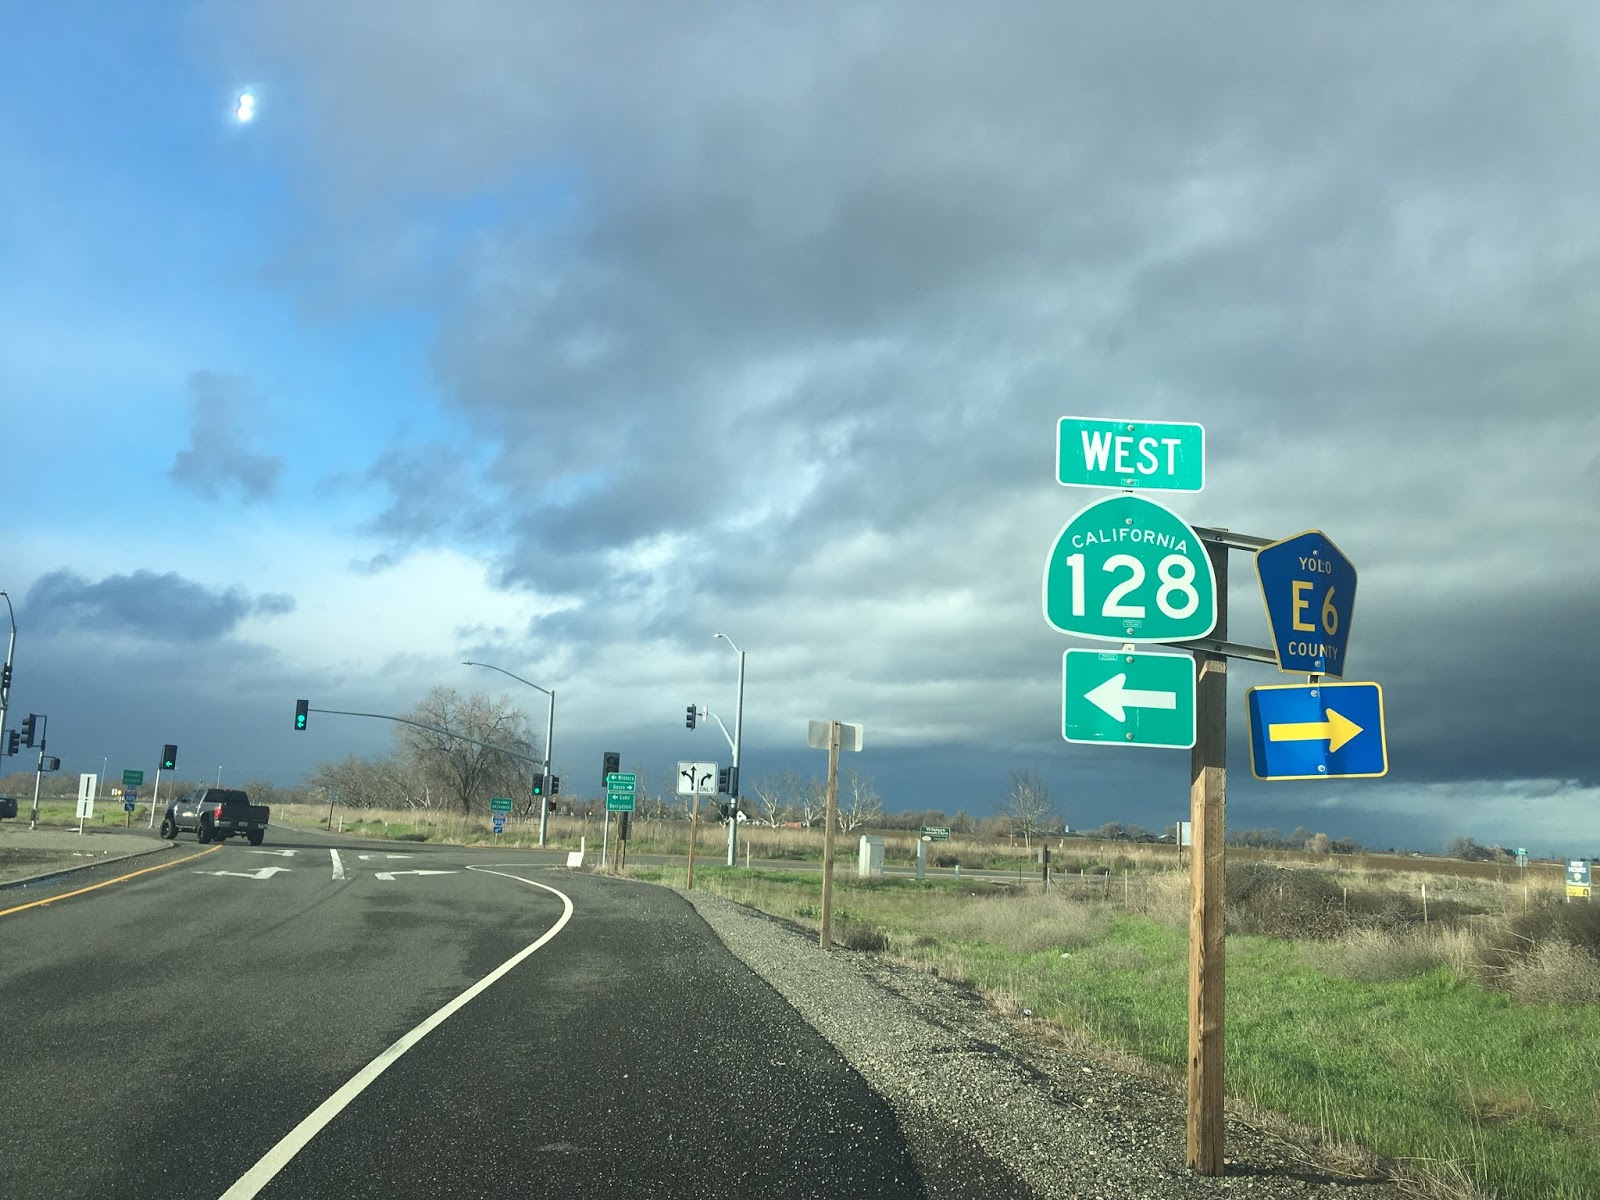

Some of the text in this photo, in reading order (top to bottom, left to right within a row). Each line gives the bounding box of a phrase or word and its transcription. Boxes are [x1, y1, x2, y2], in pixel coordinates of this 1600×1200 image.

[1081, 430, 1181, 476] WEST
[1071, 527, 1188, 555] CALIFORNIA
[1298, 556, 1332, 575] YOLO
[1066, 553, 1199, 620] 128
[1288, 641, 1339, 661] COUNTY
